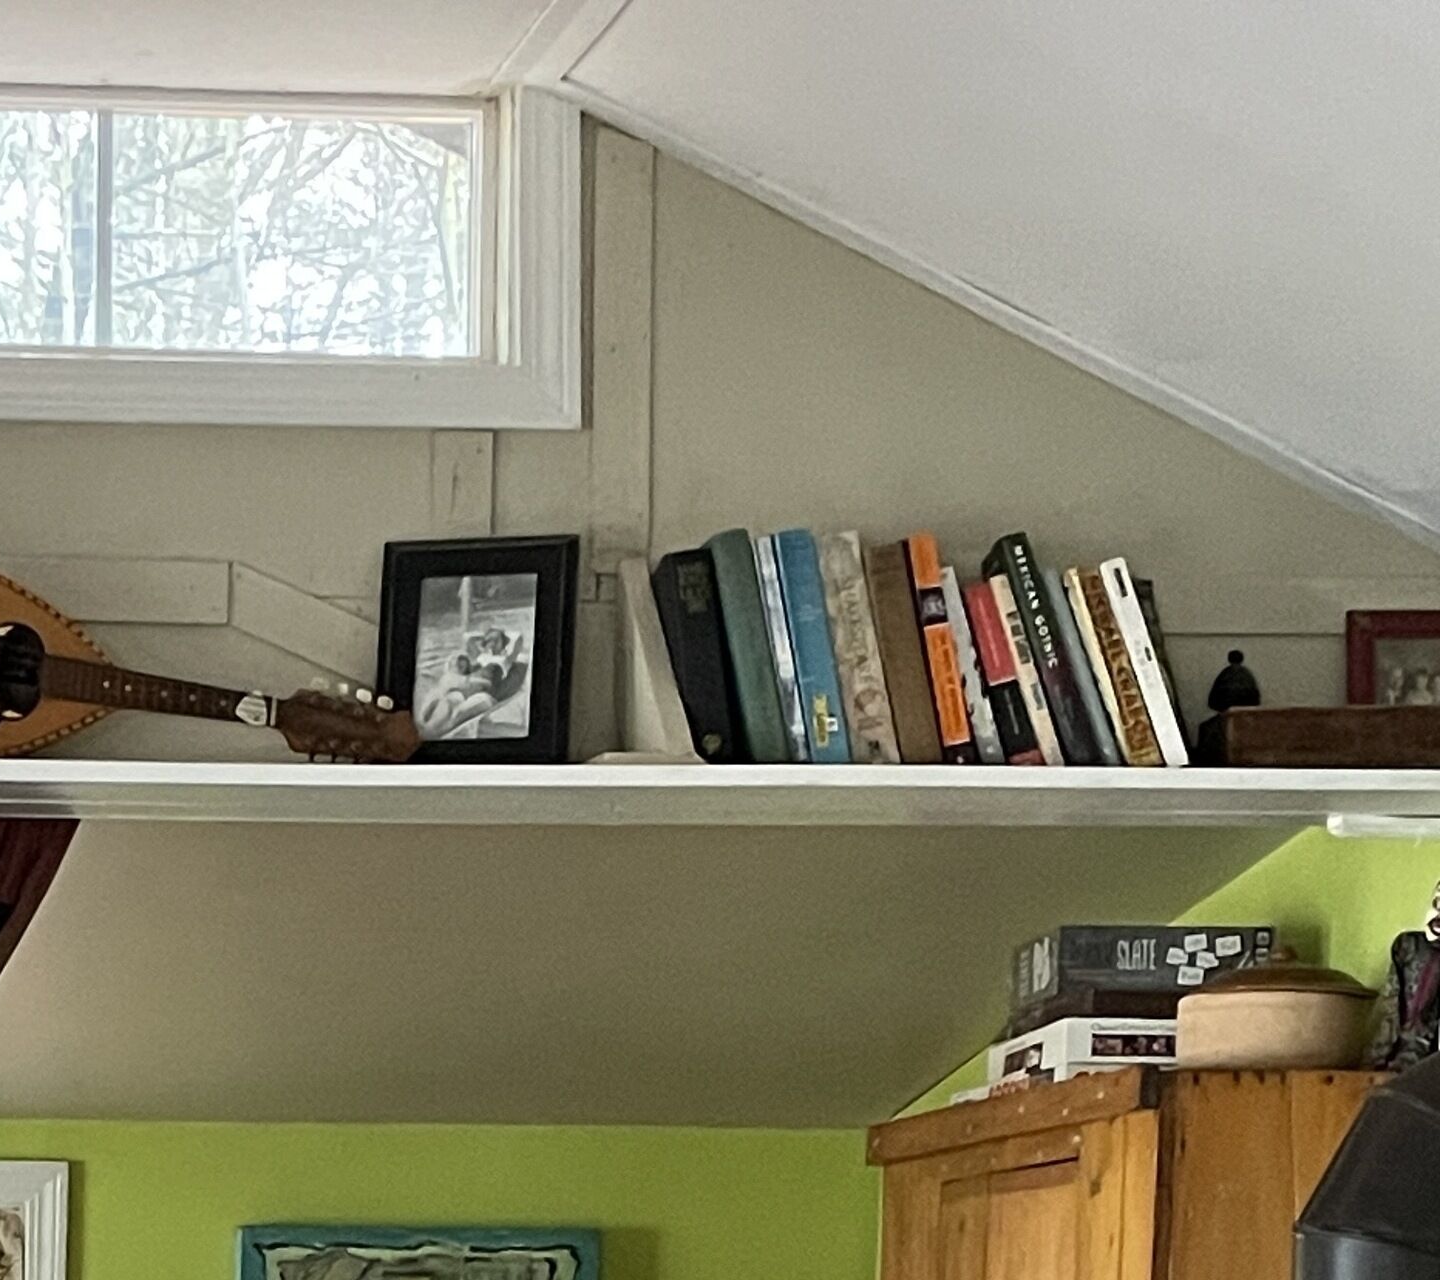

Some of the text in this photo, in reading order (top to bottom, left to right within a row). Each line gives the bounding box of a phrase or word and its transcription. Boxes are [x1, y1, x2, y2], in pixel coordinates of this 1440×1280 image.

[1013, 543, 1039, 609] MEXICAN
[1033, 614, 1058, 670] GOTHIC
[1117, 938, 1157, 970] SLATE
